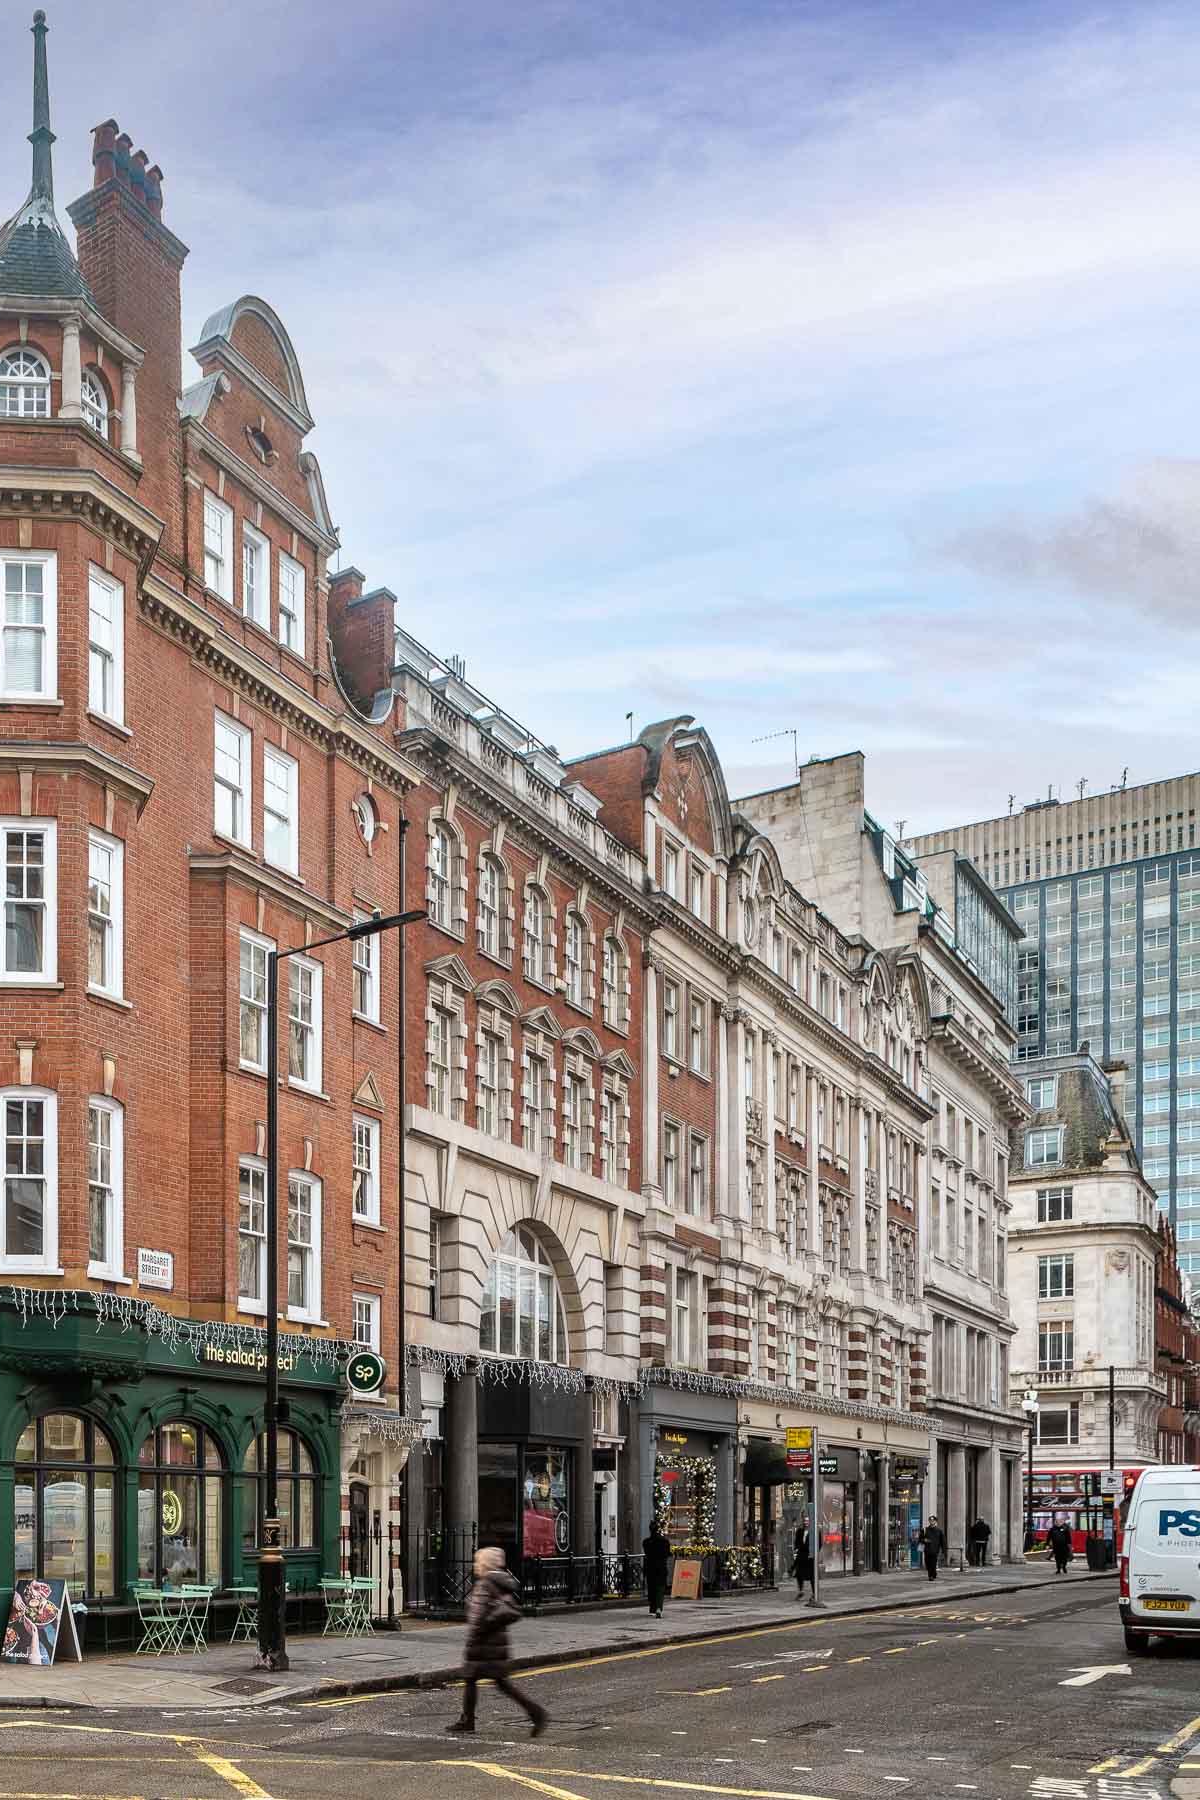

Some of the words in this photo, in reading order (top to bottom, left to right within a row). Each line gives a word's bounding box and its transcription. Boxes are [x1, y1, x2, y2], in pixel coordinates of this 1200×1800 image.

[141, 1252, 169, 1267] MARGARET
[141, 1263, 160, 1276] STREET
[206, 1341, 224, 1361] the
[225, 1347, 255, 1367] salad
[257, 1354, 293, 1372] prect
